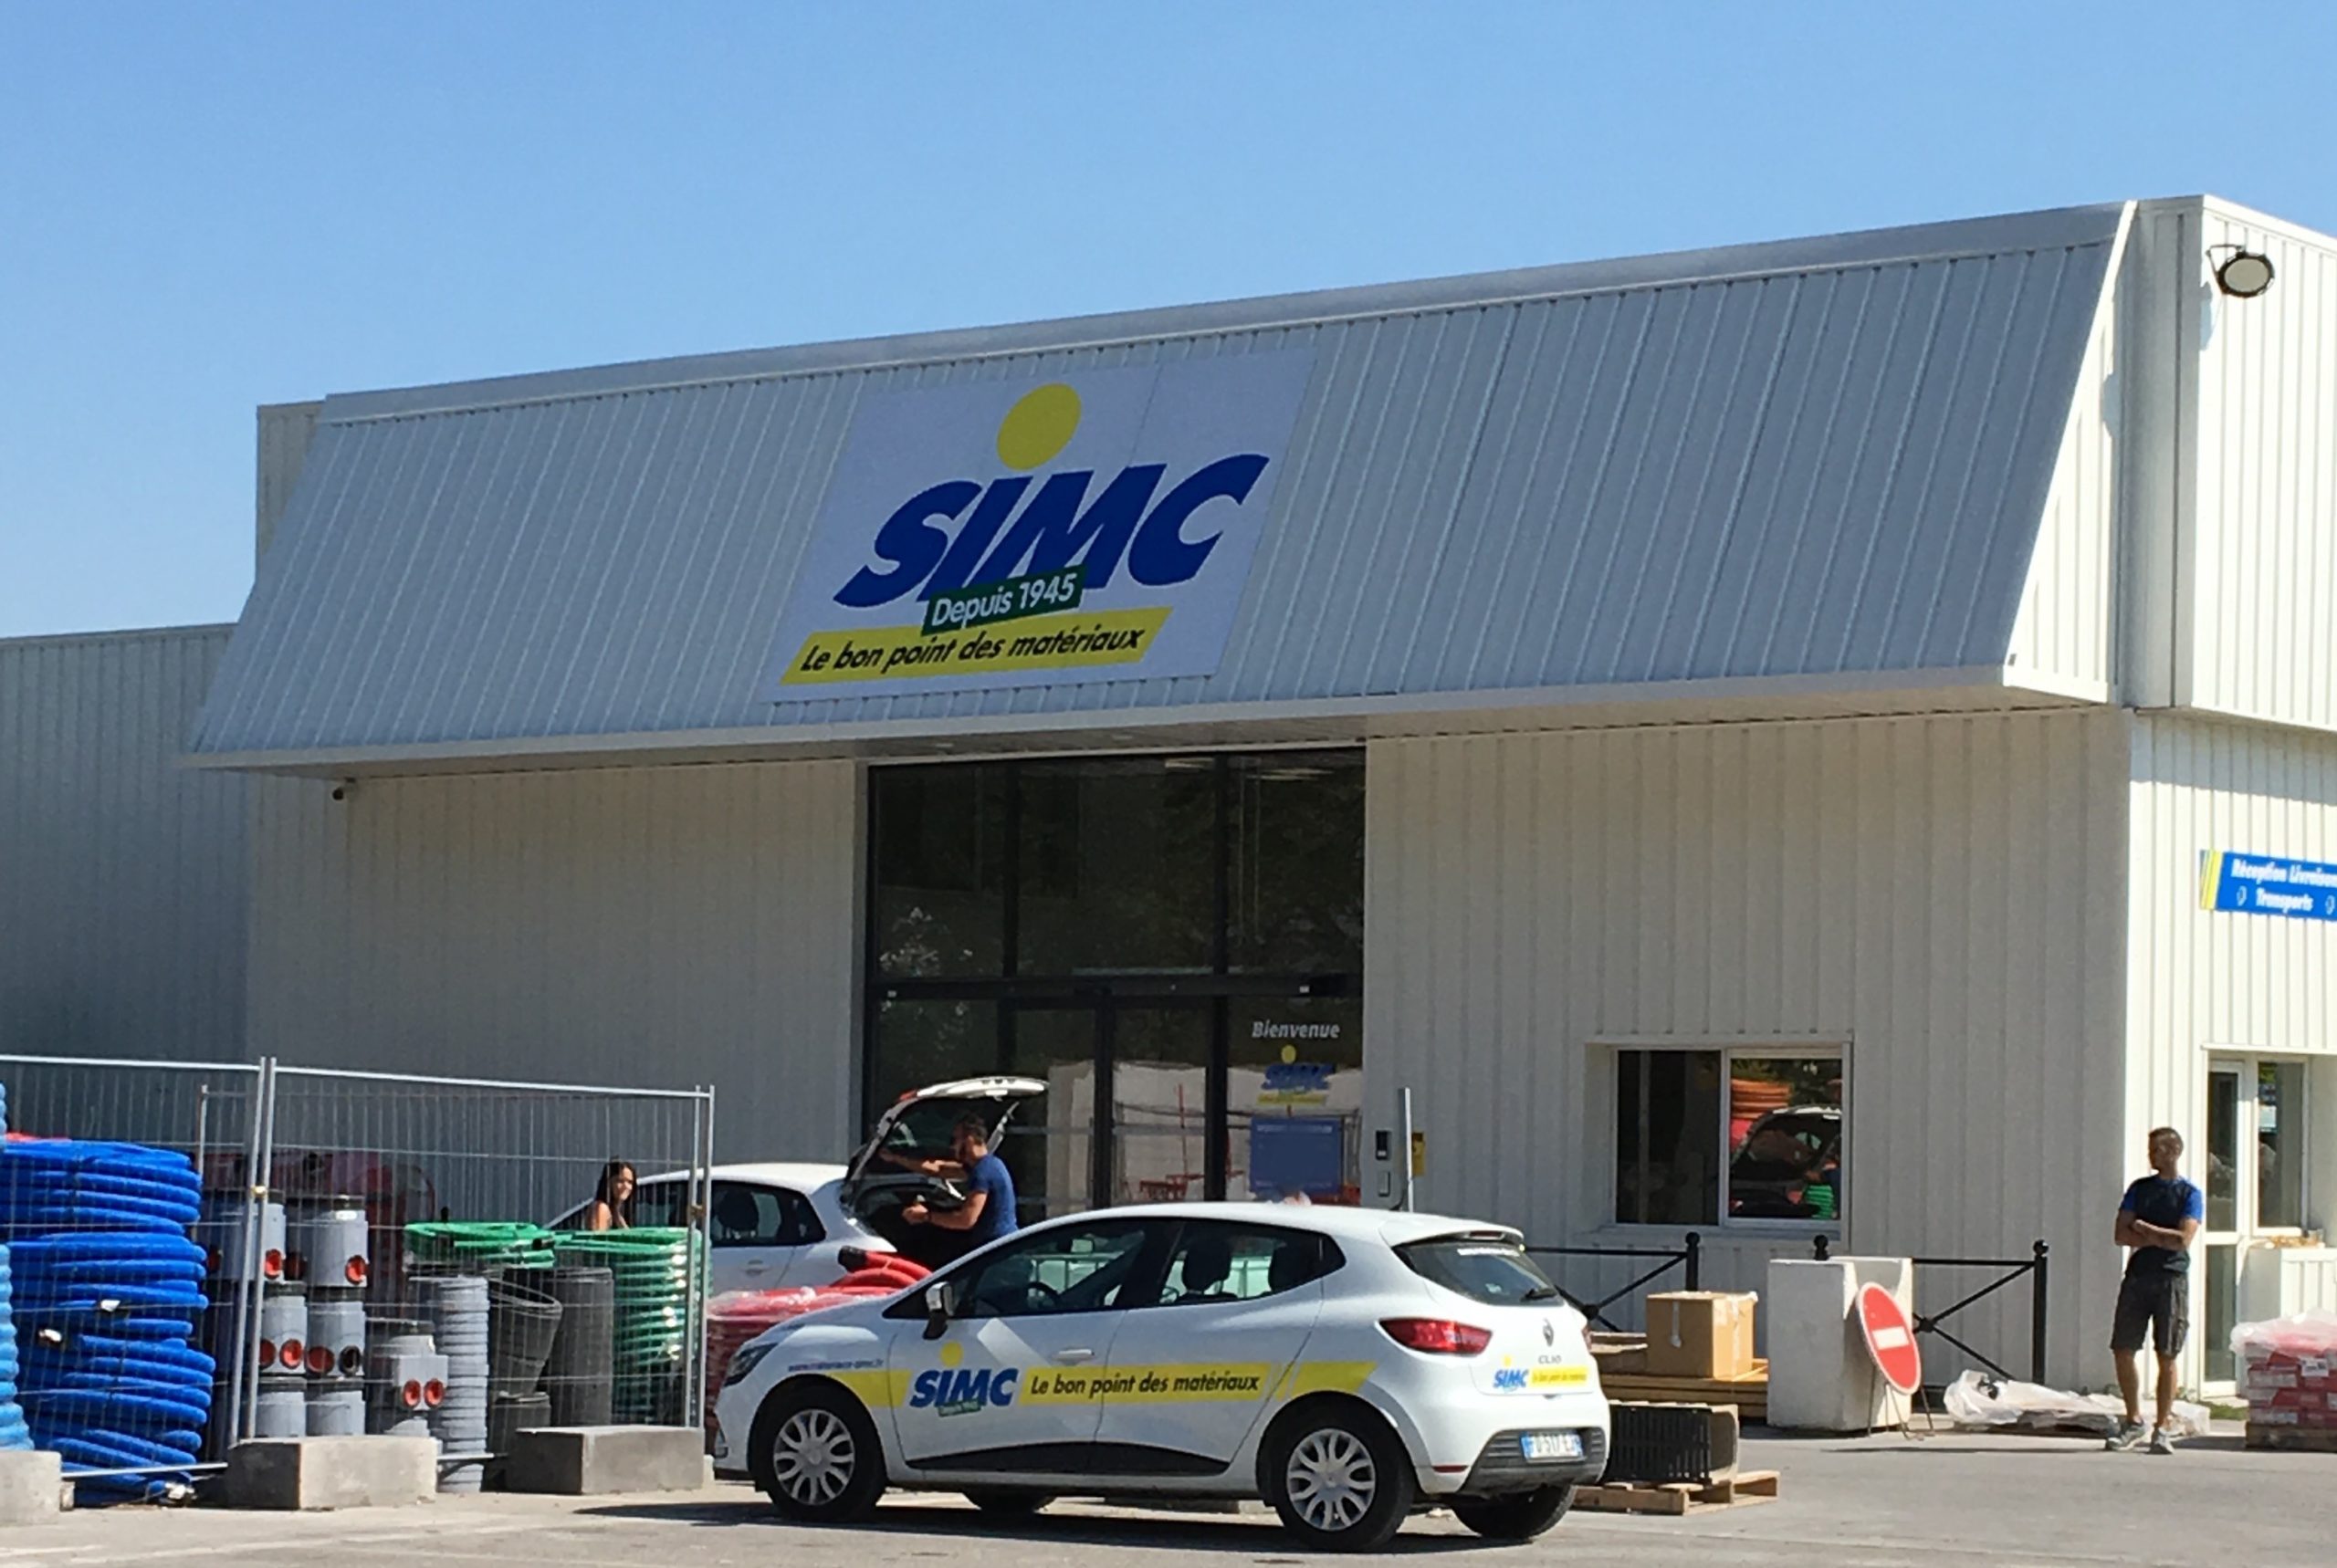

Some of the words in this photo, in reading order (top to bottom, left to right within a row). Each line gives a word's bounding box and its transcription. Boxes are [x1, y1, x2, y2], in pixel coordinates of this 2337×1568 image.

[833, 454, 1270, 608] SIMC
[931, 585, 1013, 629] Depuis
[1020, 572, 1077, 610] 1945
[800, 644, 832, 672] Le
[833, 640, 885, 669] bon
[880, 635, 958, 674] point
[958, 630, 1006, 661] des
[1007, 624, 1145, 658] matériaux
[1252, 1019, 1341, 1039] Bienvenue
[909, 1367, 1020, 1408] SIMC
[1030, 1375, 1049, 1395] Le
[1052, 1374, 1086, 1395] bon
[1087, 1373, 1137, 1398] point
[1138, 1372, 1169, 1393] des
[1173, 1370, 1261, 1393] matériaux
[1493, 1369, 1529, 1388] SIMC
